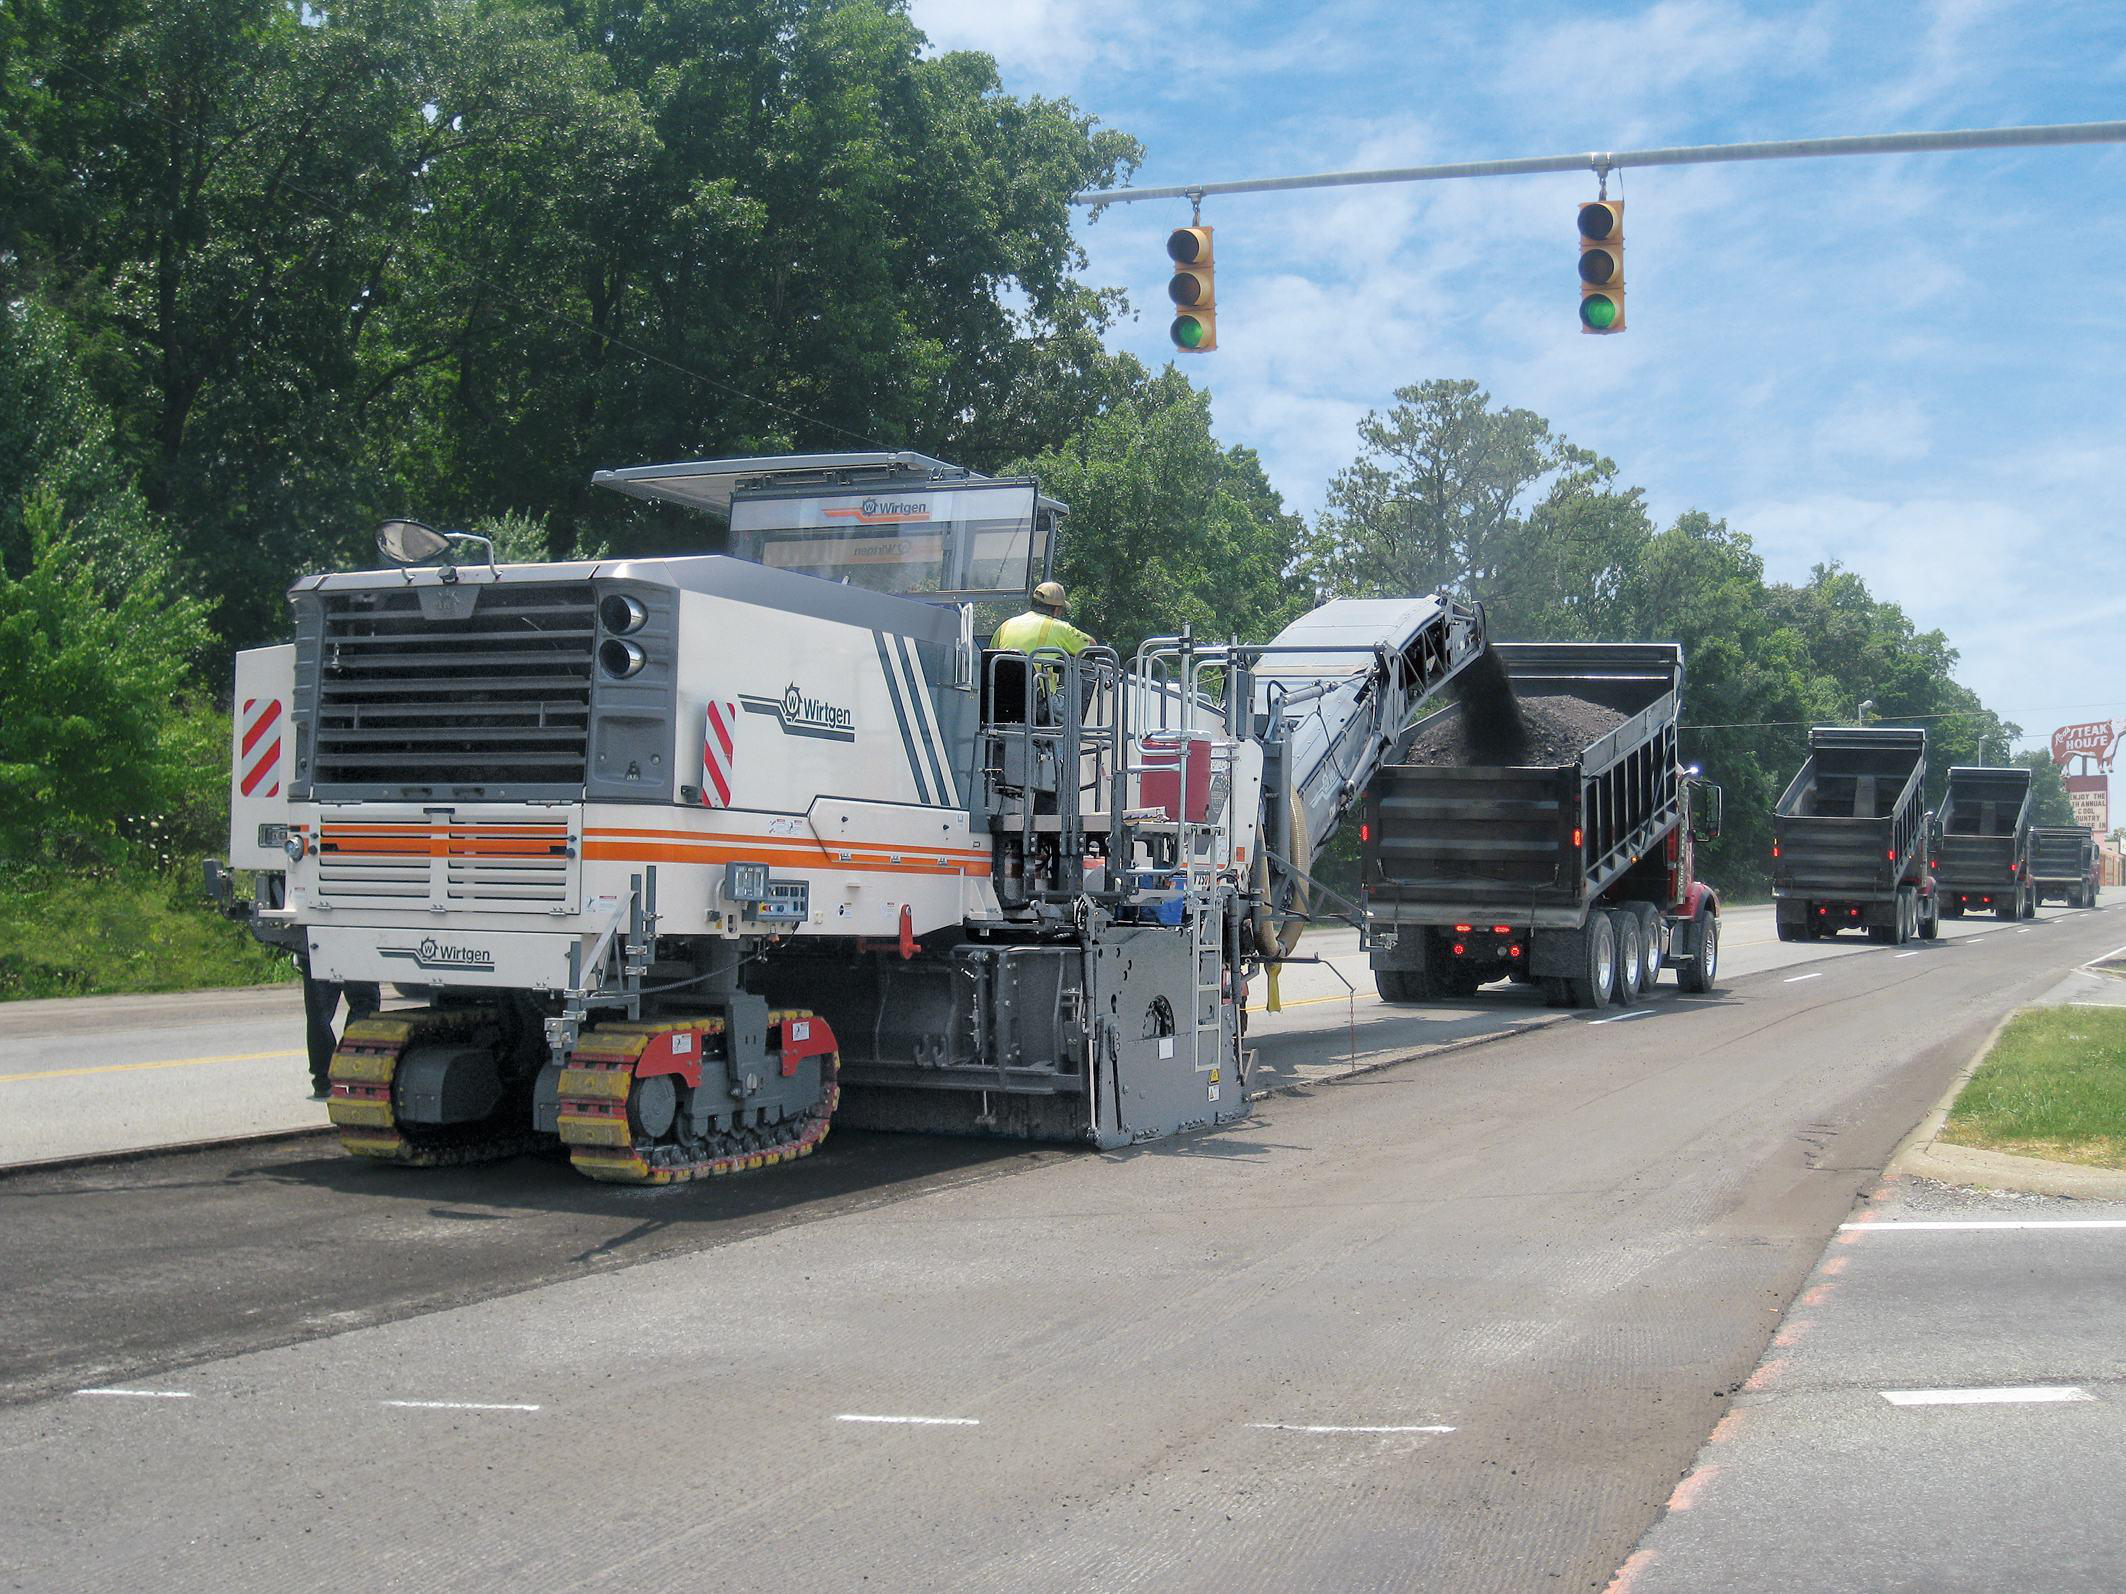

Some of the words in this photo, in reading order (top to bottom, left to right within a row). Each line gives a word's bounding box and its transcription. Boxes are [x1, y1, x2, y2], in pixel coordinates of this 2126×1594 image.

[880, 502, 926, 516] Wirtgen
[804, 698, 851, 728] Wirtgen
[2066, 724, 2108, 739] STEAK
[2066, 736, 2107, 750] HOUSE
[440, 946, 490, 963] Wirtgen
